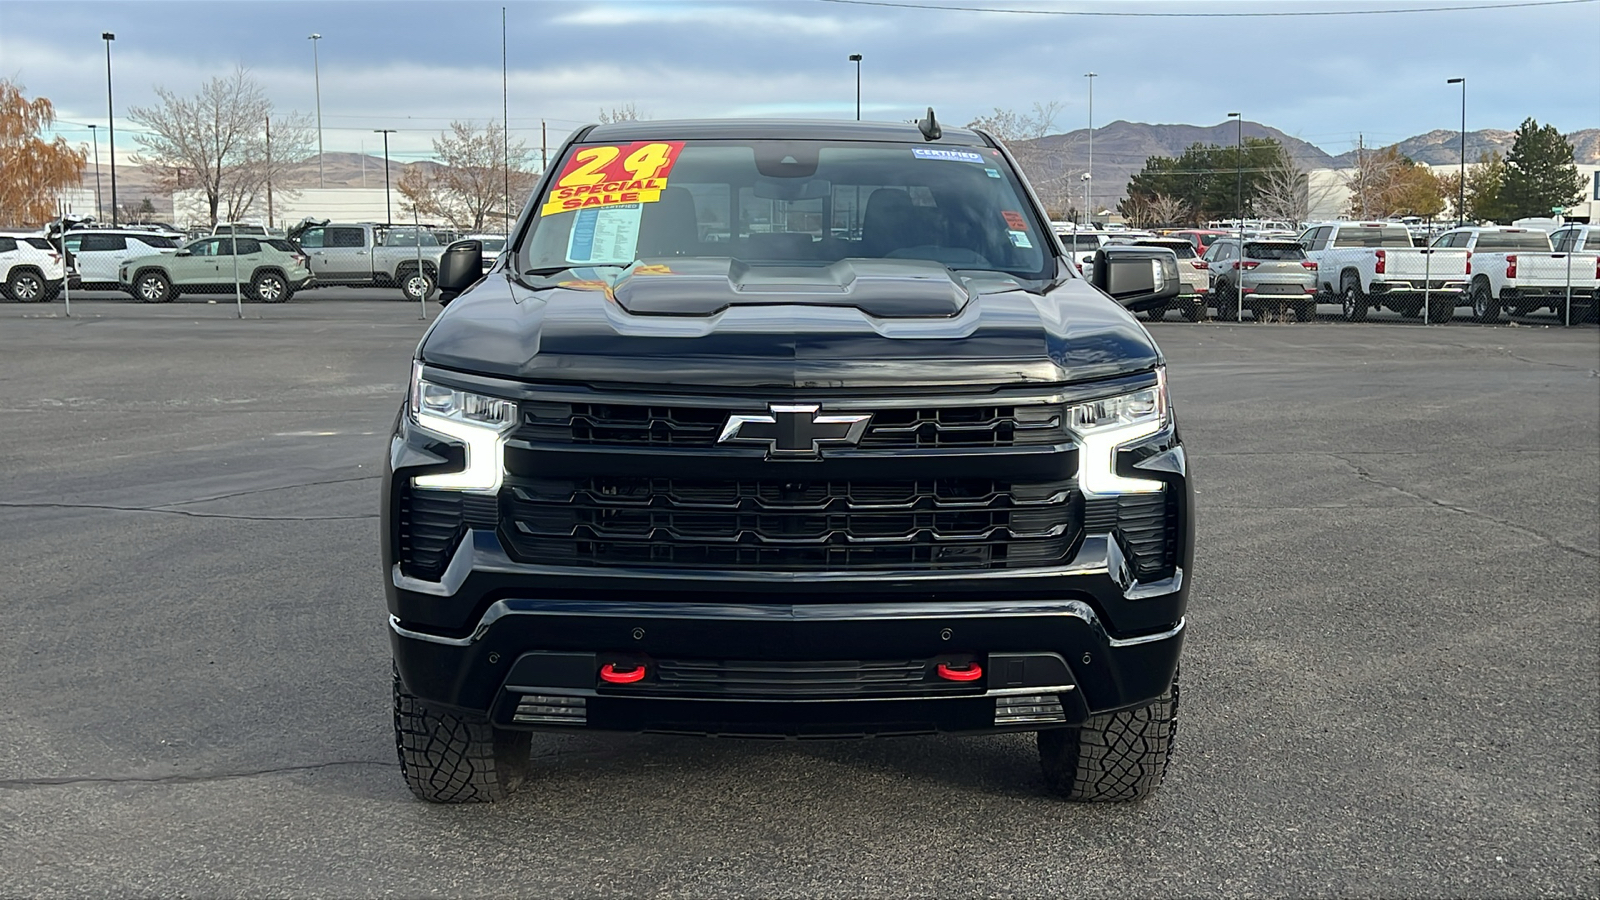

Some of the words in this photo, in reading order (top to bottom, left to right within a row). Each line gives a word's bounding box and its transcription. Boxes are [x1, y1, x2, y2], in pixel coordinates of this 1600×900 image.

[915, 149, 979, 159] CERTIFIED
[559, 143, 672, 187] 24
[558, 179, 660, 199] SPECIAL
[562, 192, 640, 210] SALE
